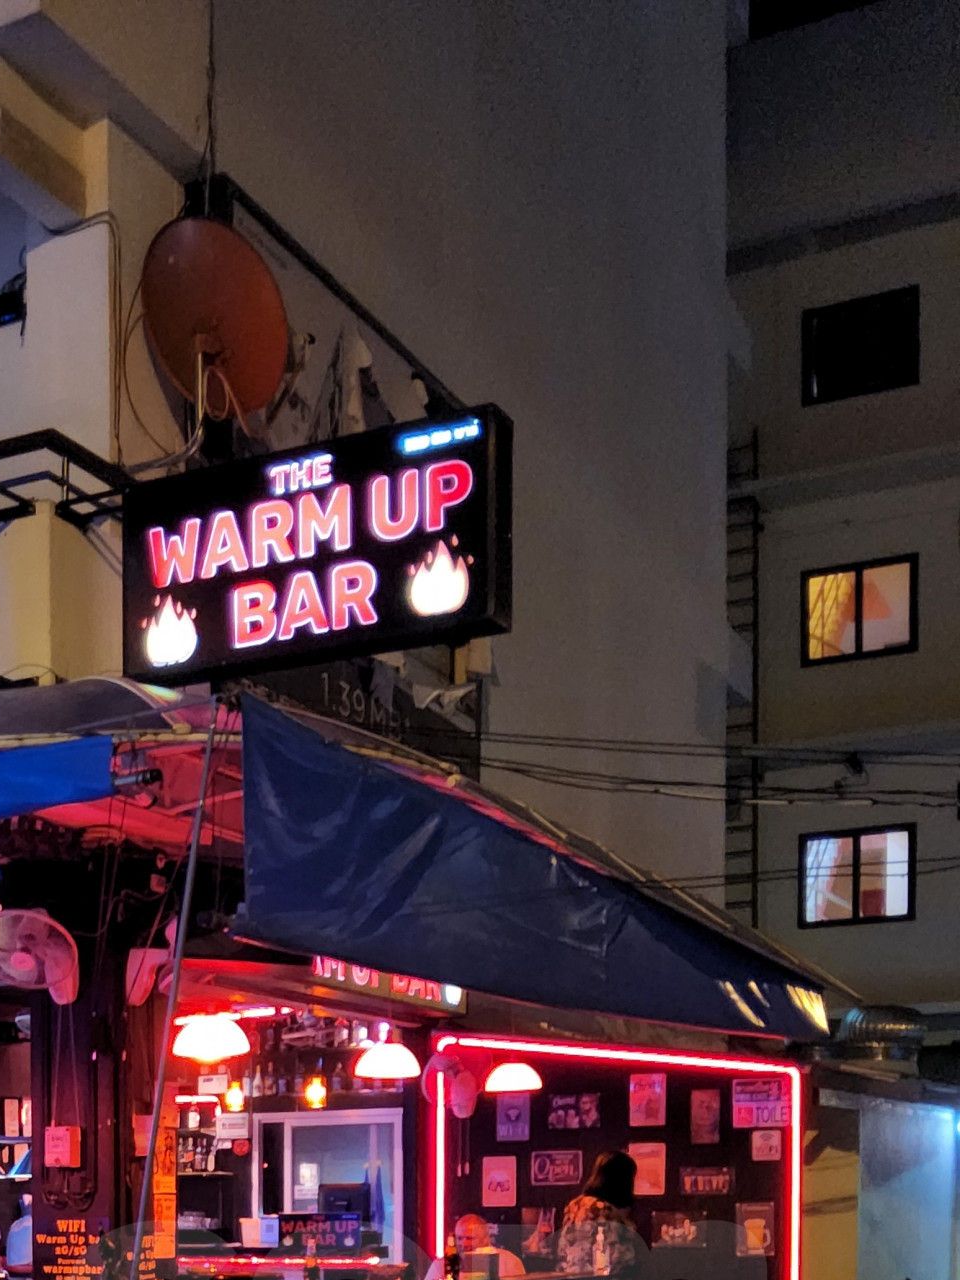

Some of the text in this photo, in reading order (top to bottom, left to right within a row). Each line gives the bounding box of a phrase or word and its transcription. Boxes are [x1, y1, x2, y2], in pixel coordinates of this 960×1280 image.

[268, 454, 334, 495] THE
[148, 459, 474, 589] WARM UP
[231, 561, 379, 649] BAR
[36, 1234, 67, 1244] Warm
[70, 1234, 85, 1246] Up
[281, 1219, 360, 1234] WARM UP
